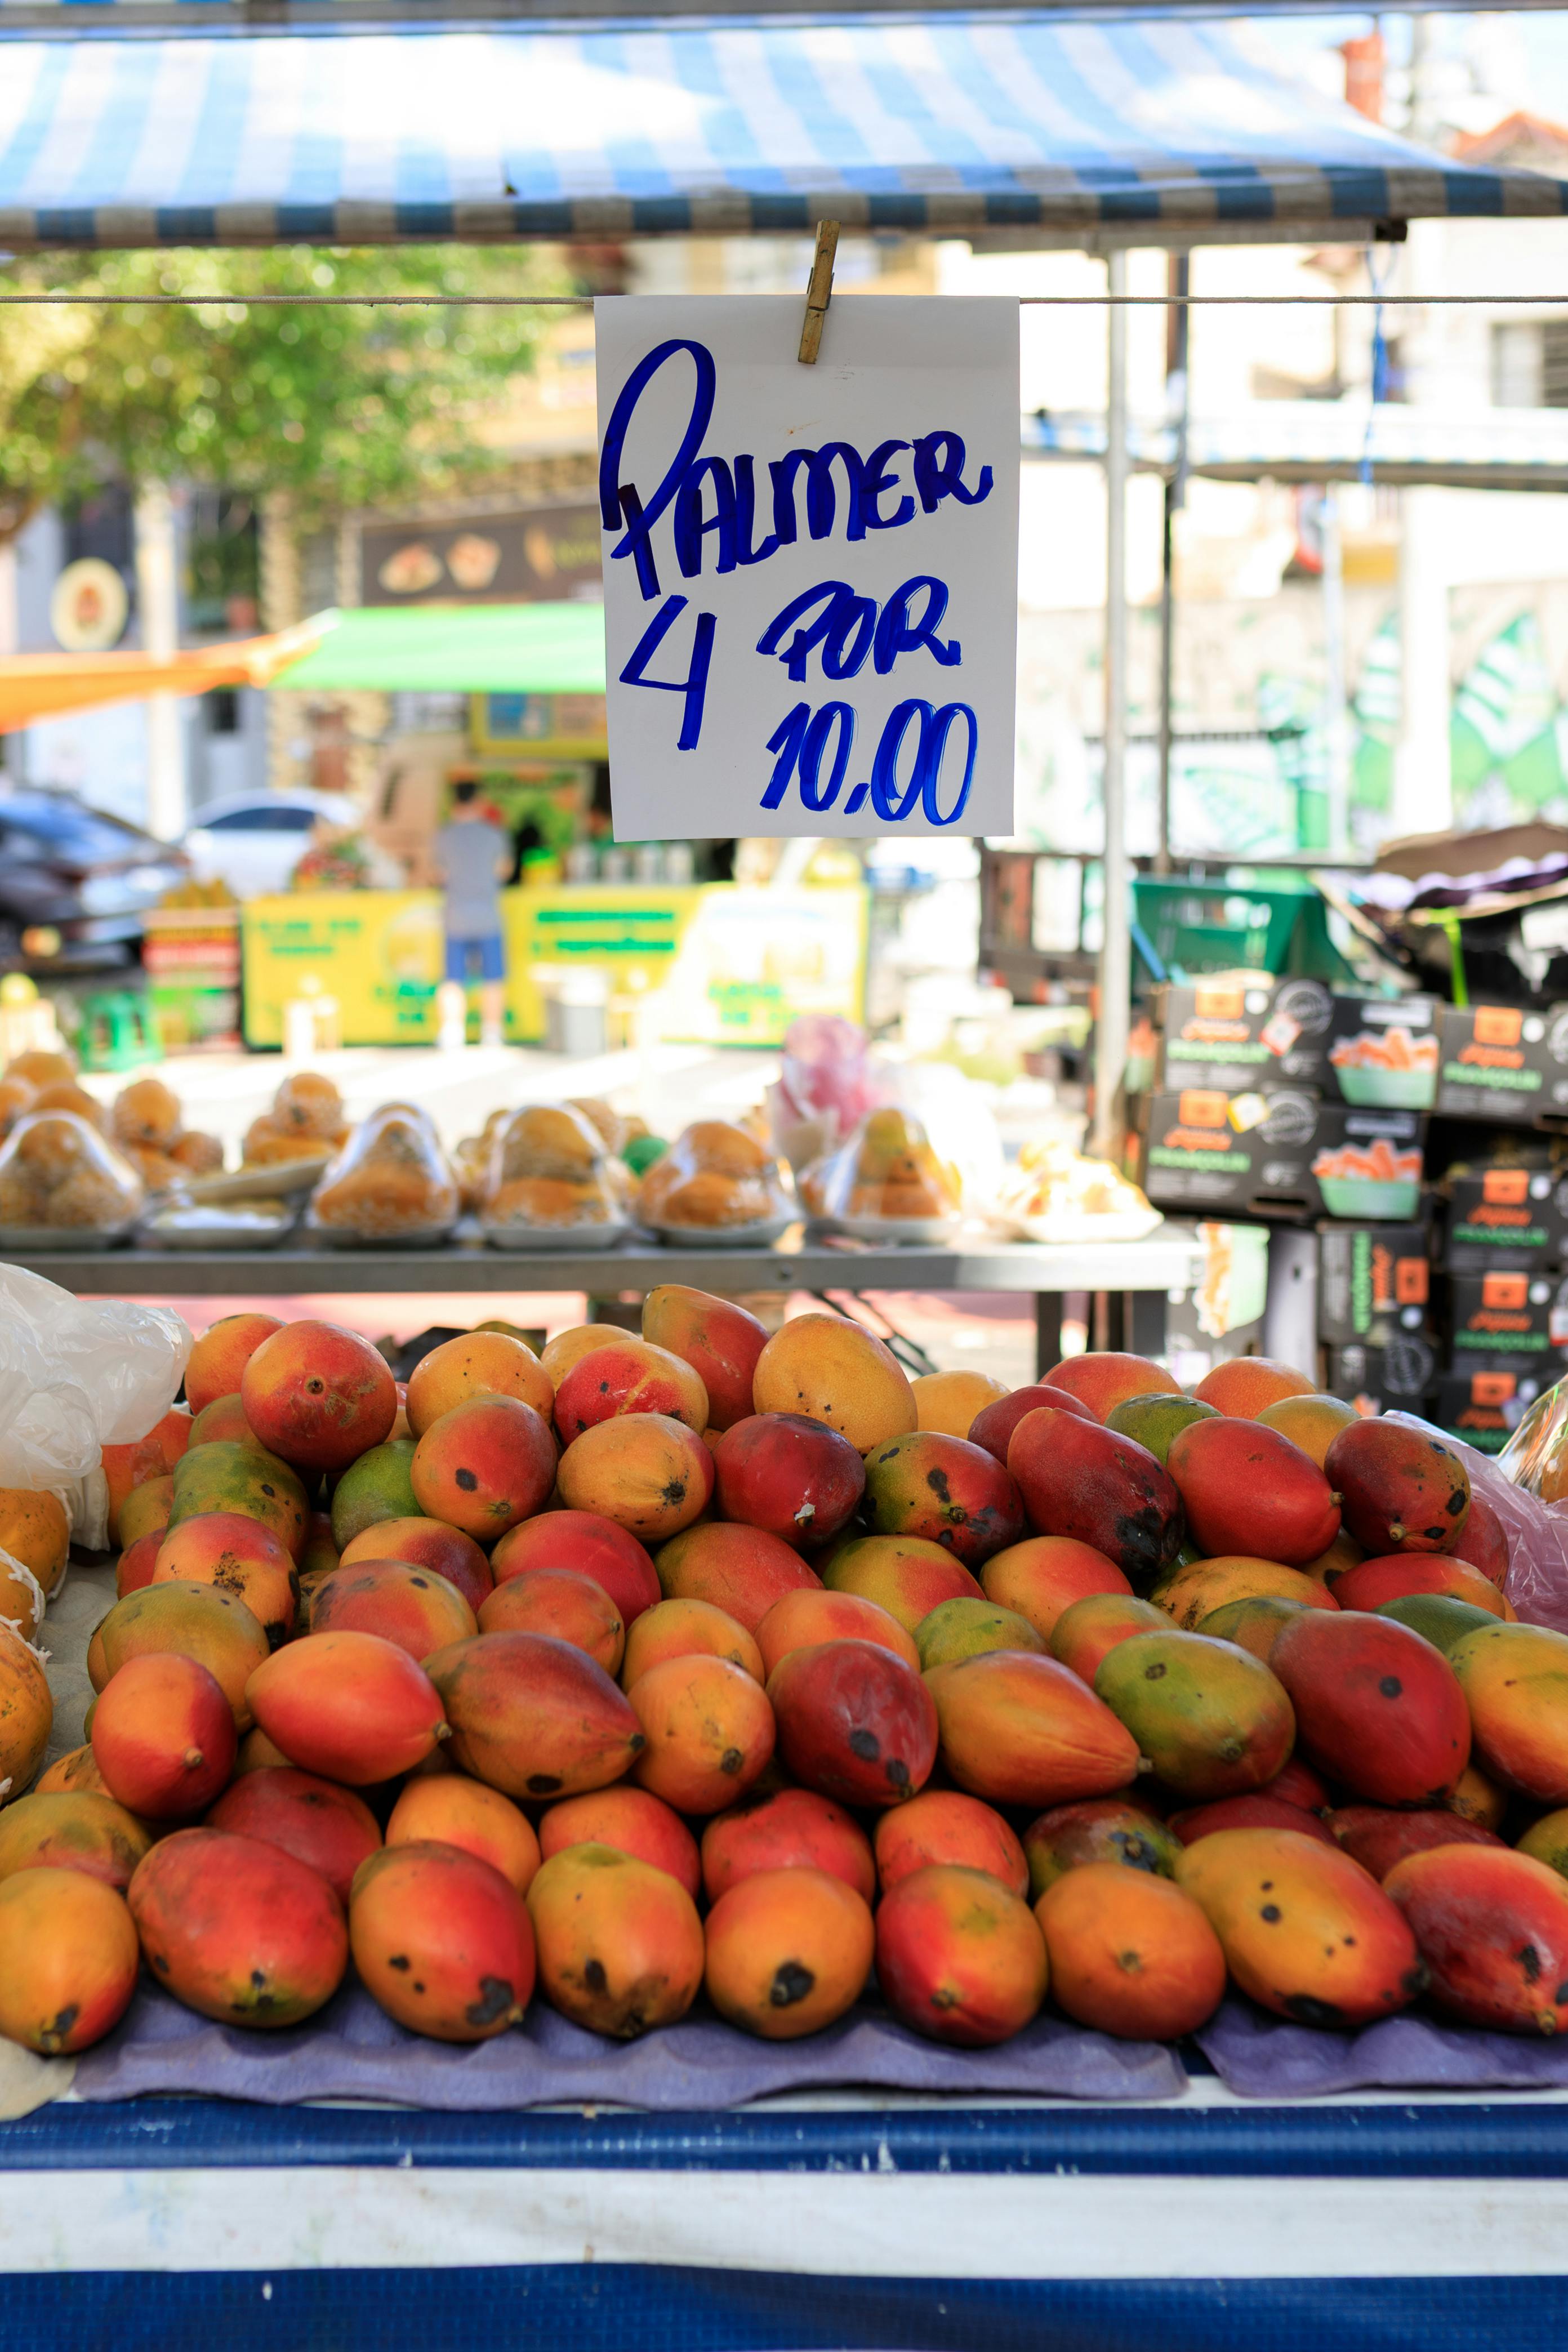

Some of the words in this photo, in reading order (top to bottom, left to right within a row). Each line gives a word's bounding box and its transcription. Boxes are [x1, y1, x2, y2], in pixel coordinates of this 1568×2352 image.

[600, 339, 994, 601] PALMER
[619, 594, 717, 751] 4
[756, 575, 962, 683] POR
